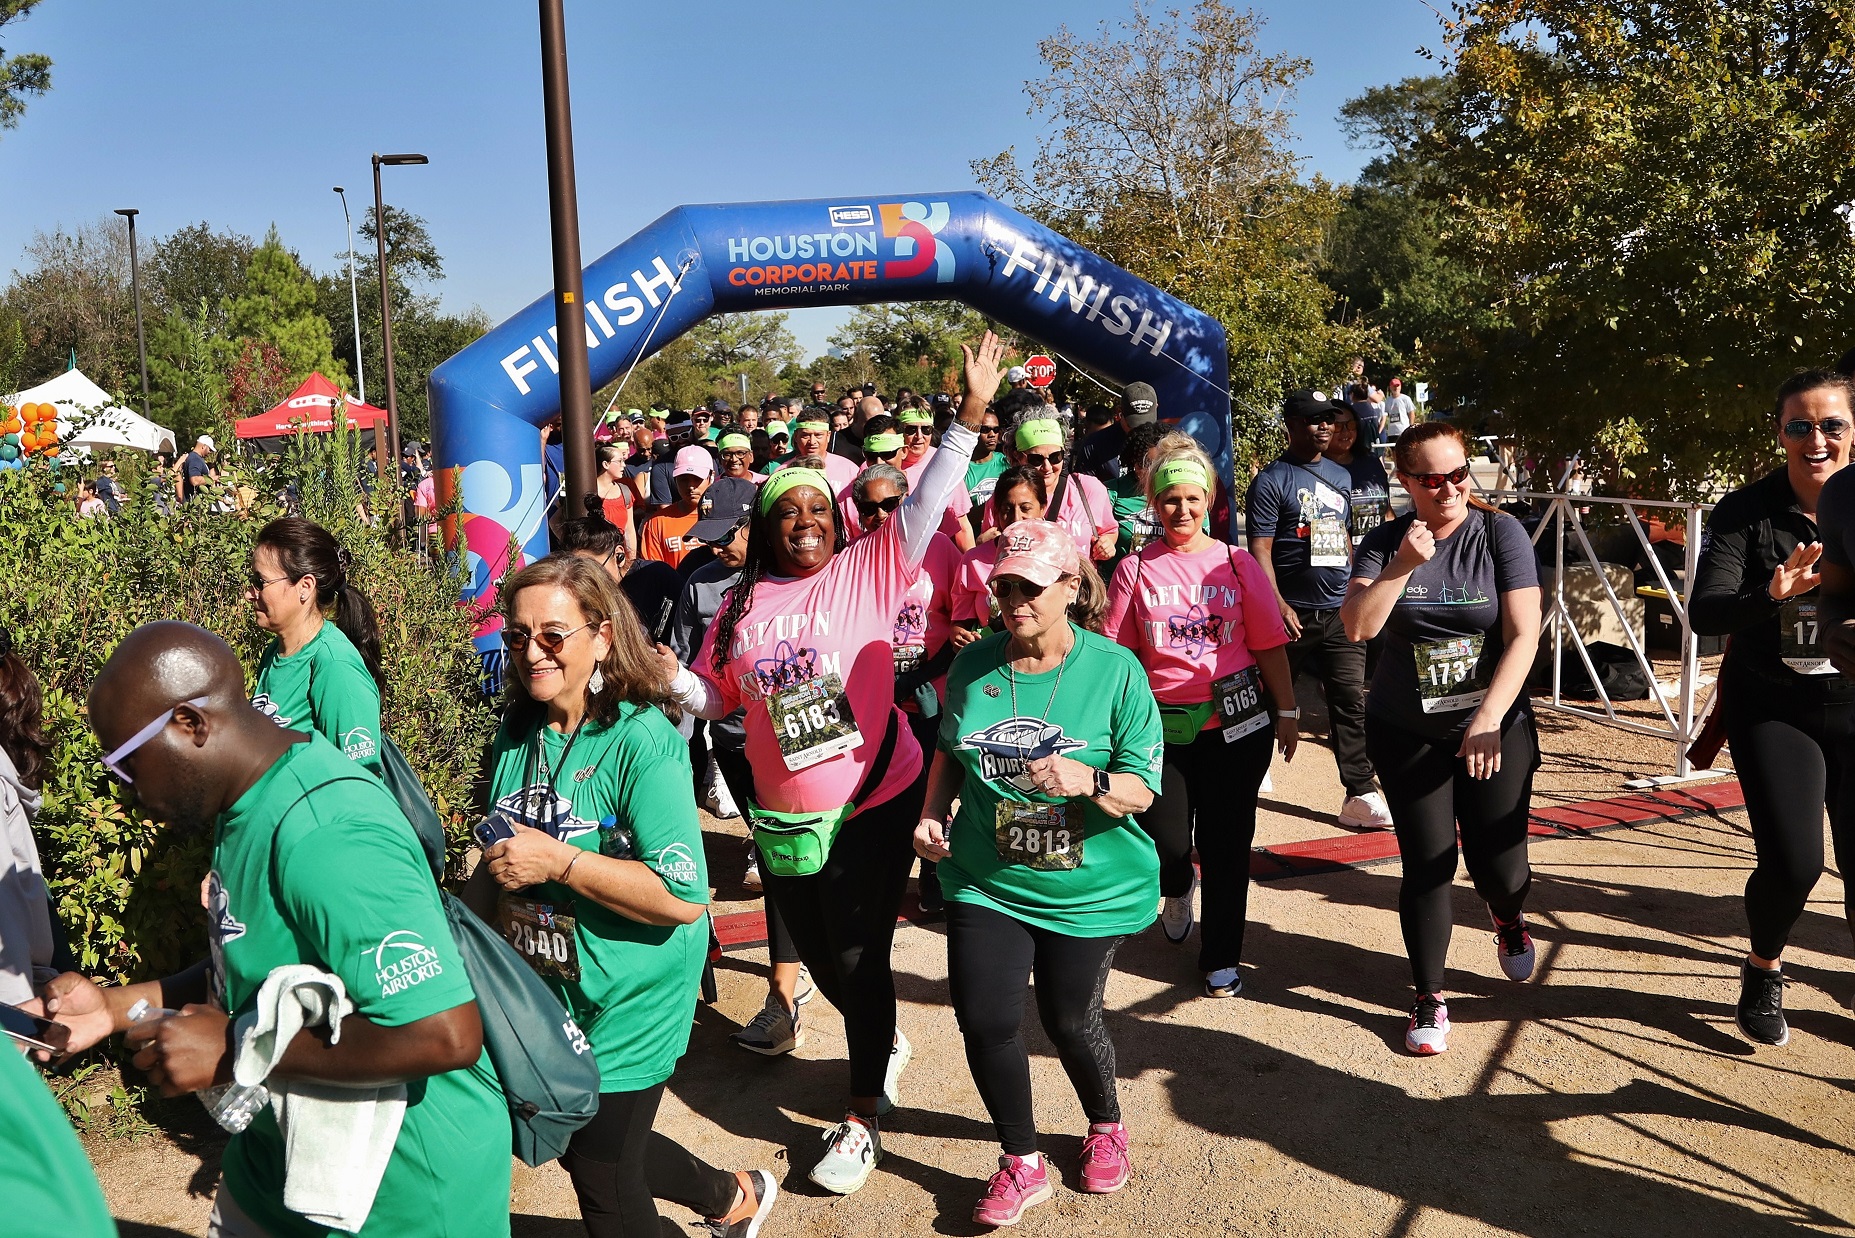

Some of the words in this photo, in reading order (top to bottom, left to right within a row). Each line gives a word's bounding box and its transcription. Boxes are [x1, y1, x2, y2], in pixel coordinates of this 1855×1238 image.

[833, 210, 870, 221] HESS
[728, 231, 877, 263] HOUSTON
[728, 260, 877, 287] CORPORATE
[754, 284, 816, 296] MEMORIAL
[819, 283, 850, 293] PARK
[1002, 242, 1173, 357] FINISH
[500, 255, 682, 396] FINISH
[1026, 364, 1054, 378] STOP
[782, 470, 798, 478] TPC
[1356, 515, 1381, 530] 1799
[1314, 533, 1345, 548] 2234
[1144, 584, 1182, 608] GET
[1406, 584, 1428, 596] edp
[732, 621, 769, 660] GET
[1793, 621, 1818, 645] 17
[894, 660, 920, 673] 162
[1223, 685, 1258, 716] 6165
[783, 699, 841, 739] 6183
[343, 739, 376, 754] HOUSTON
[803, 747, 823, 760] ARNOLD
[984, 753, 1020, 778] AVIA
[1009, 826, 1070, 855] 2813
[655, 861, 697, 873] HOUSTON
[511, 920, 568, 963] 2840
[376, 946, 438, 986] HOUSTON
[382, 960, 443, 1000] AIRPORTS
